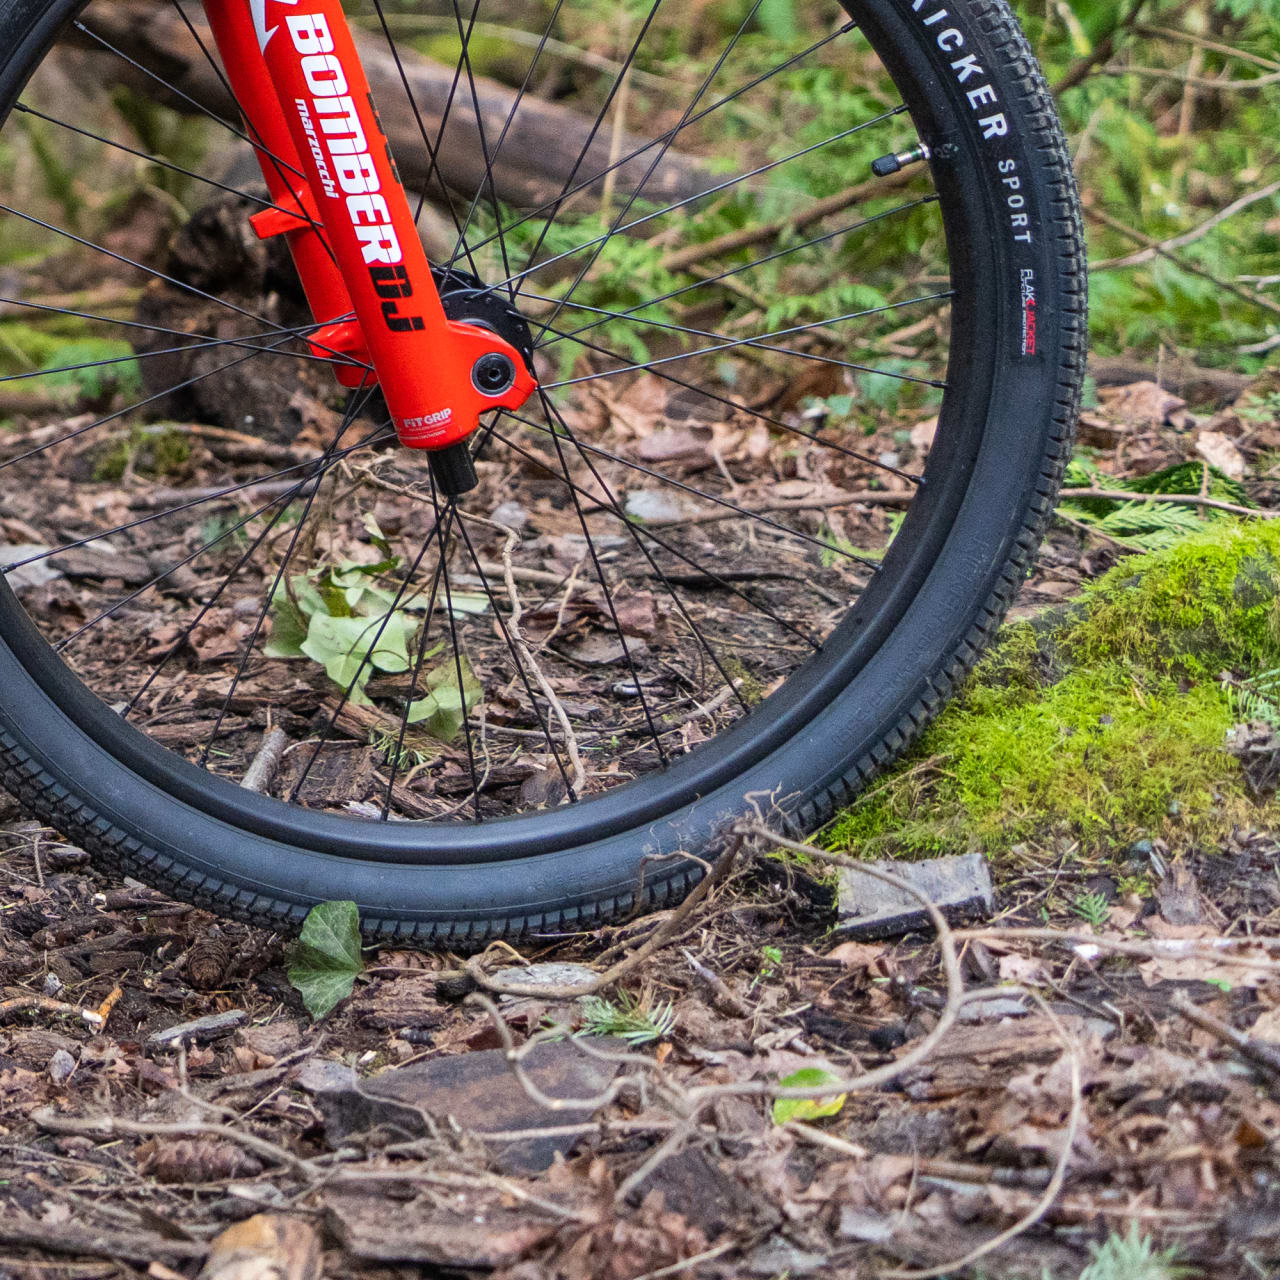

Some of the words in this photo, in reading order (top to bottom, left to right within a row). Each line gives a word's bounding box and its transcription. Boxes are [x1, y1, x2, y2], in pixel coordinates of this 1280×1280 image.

[285, 12, 403, 265] BOMBER
[368, 265, 426, 333] DJ
[294, 98, 340, 200] marzocchi
[997, 158, 1032, 244] SPORT
[1023, 269, 1036, 301] FLAK
[423, 407, 452, 425] GRIP
